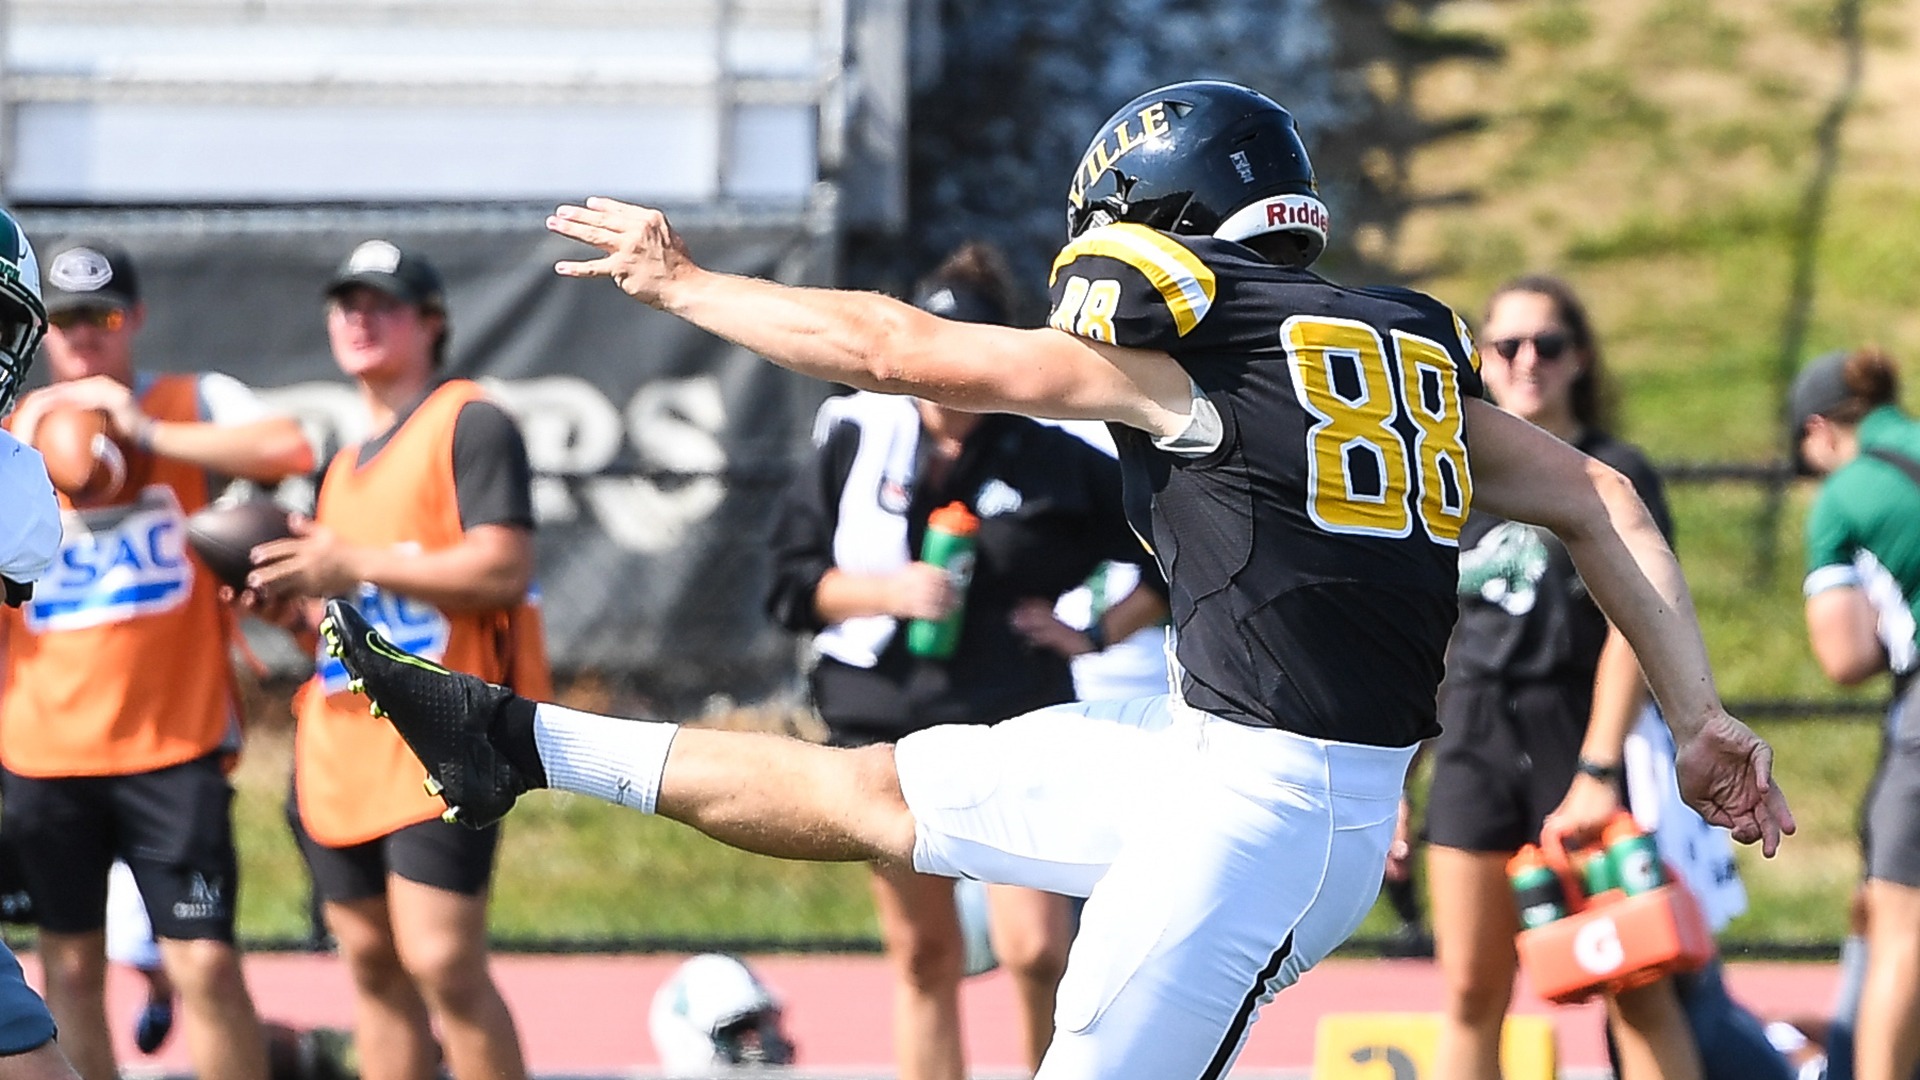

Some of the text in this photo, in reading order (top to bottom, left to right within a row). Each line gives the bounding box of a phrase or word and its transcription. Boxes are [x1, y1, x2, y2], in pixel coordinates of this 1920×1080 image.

[1068, 101, 1169, 210] VILLE
[1280, 315, 1473, 547] 88
[60, 522, 183, 589] SAC
